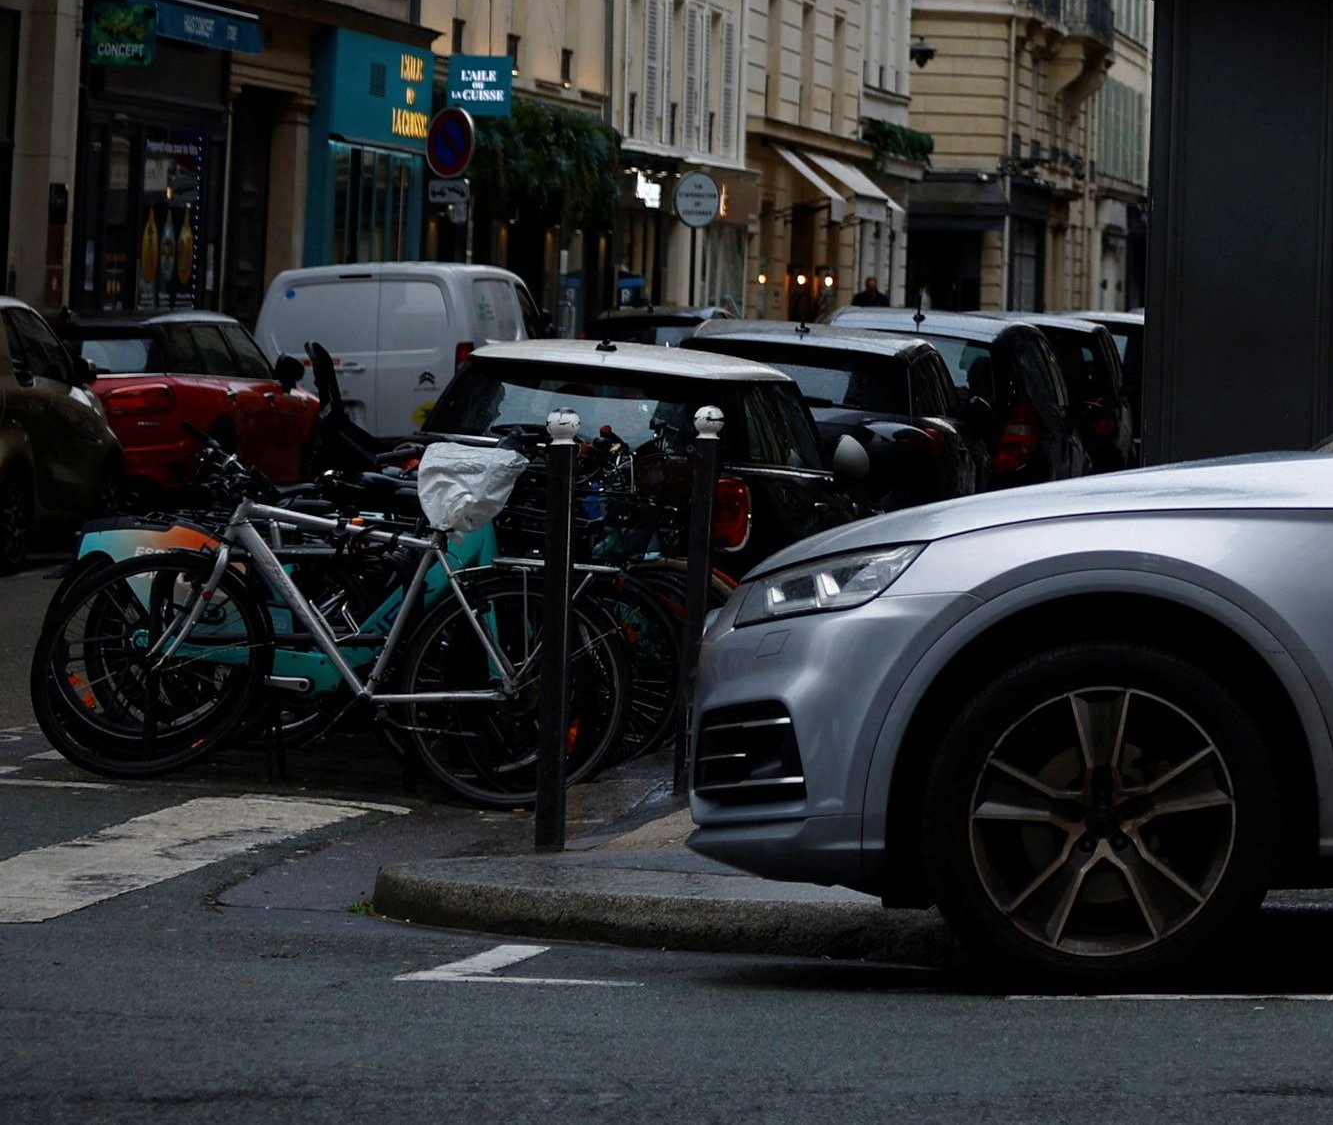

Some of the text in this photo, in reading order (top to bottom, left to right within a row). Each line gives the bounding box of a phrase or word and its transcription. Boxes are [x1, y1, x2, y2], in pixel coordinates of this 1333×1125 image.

[97, 42, 145, 57] CONCEPT
[461, 69, 497, 82] L'AILE
[451, 89, 504, 102] LA CUISSE
